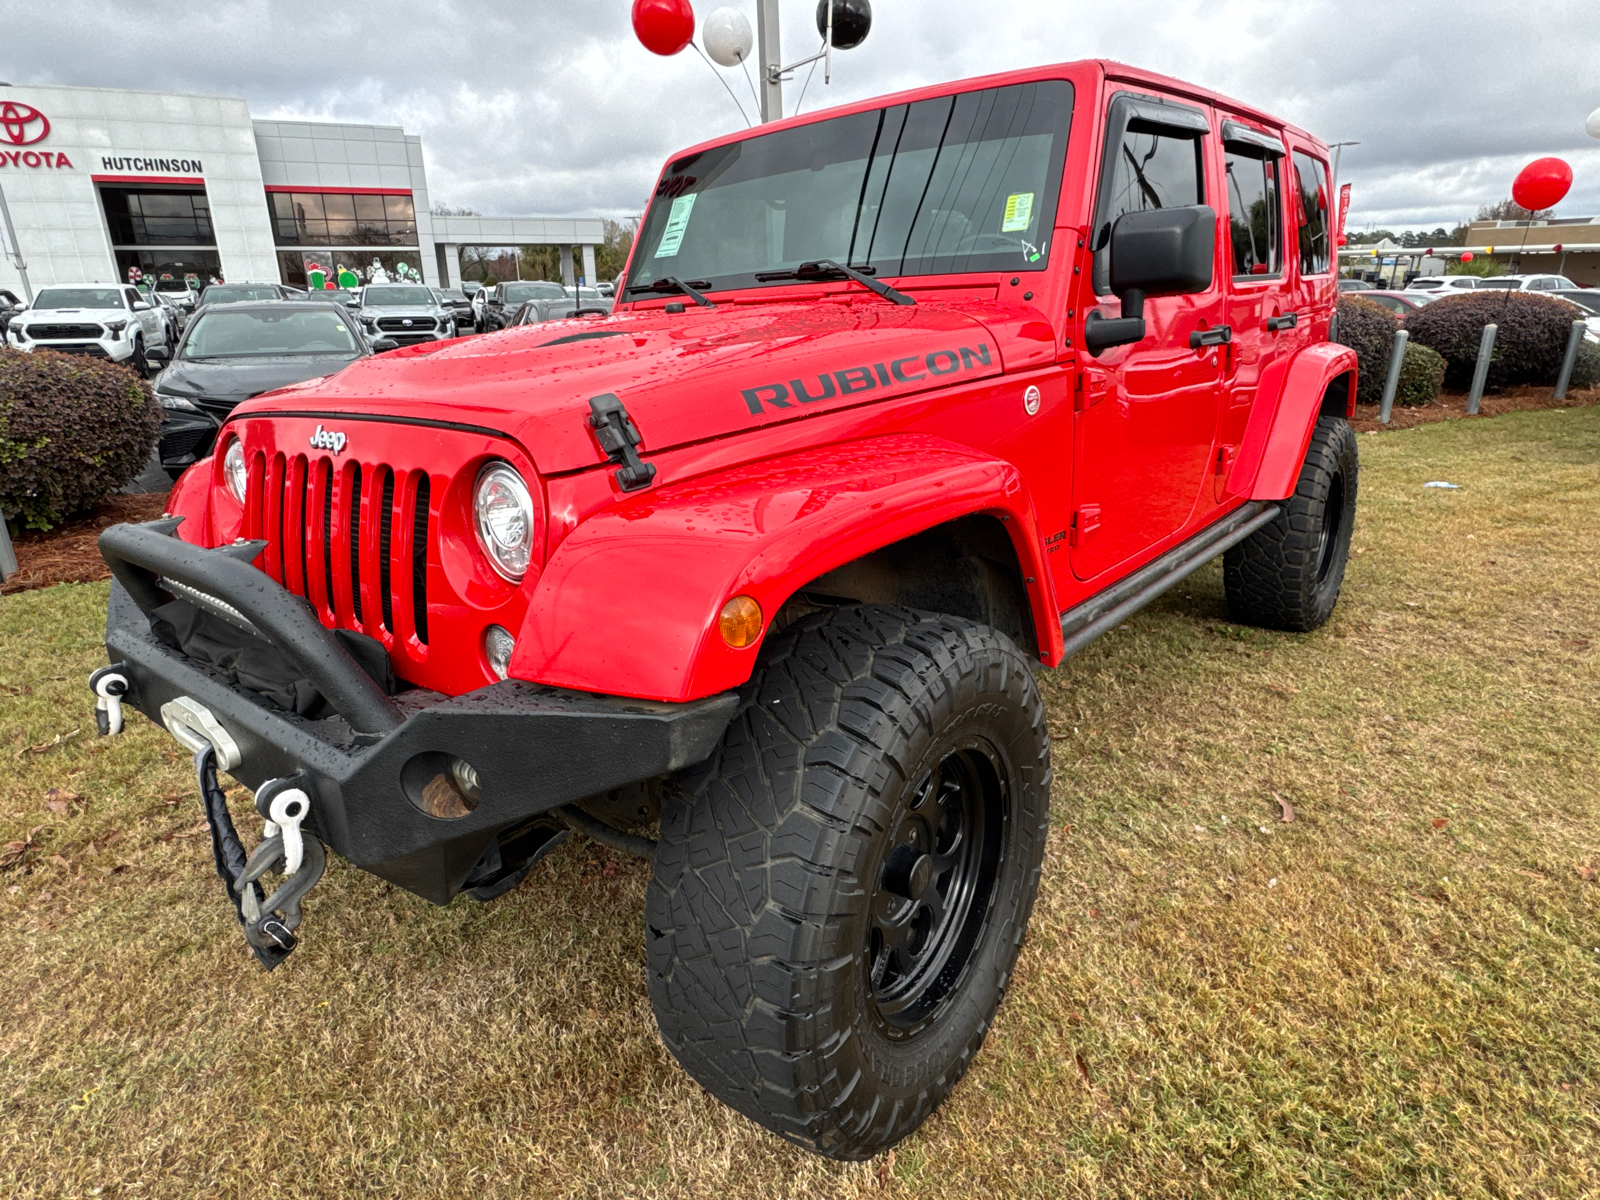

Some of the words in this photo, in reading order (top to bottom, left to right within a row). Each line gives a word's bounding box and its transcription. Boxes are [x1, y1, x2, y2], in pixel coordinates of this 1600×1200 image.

[102, 156, 203, 173] HUTCHINSON
[740, 343, 993, 416] RUBICON
[309, 424, 347, 457] Jeep
